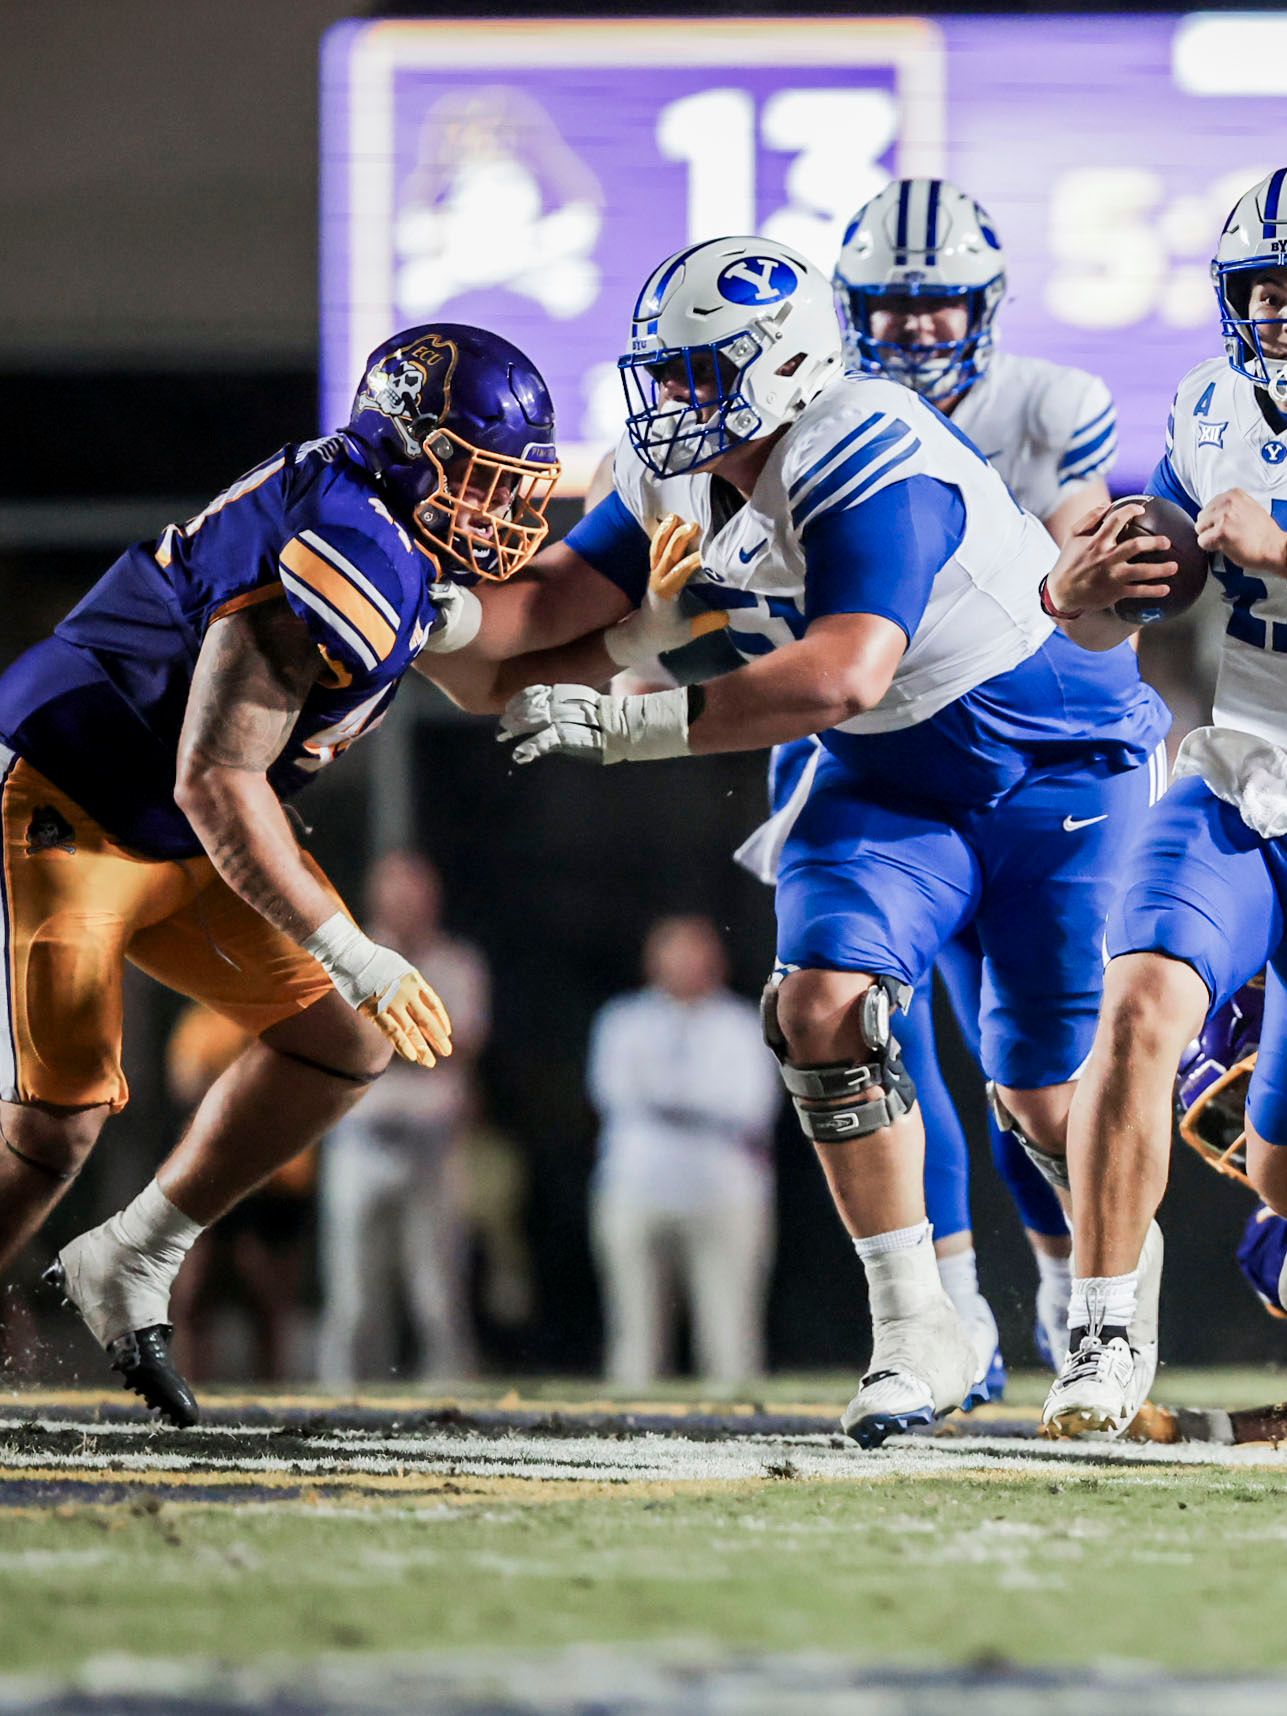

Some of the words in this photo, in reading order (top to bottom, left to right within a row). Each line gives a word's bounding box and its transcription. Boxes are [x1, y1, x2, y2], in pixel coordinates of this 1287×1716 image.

[721, 257, 789, 303] Y
[411, 346, 444, 367] ECU
[1193, 382, 1216, 417] A
[1263, 442, 1286, 463] Y
